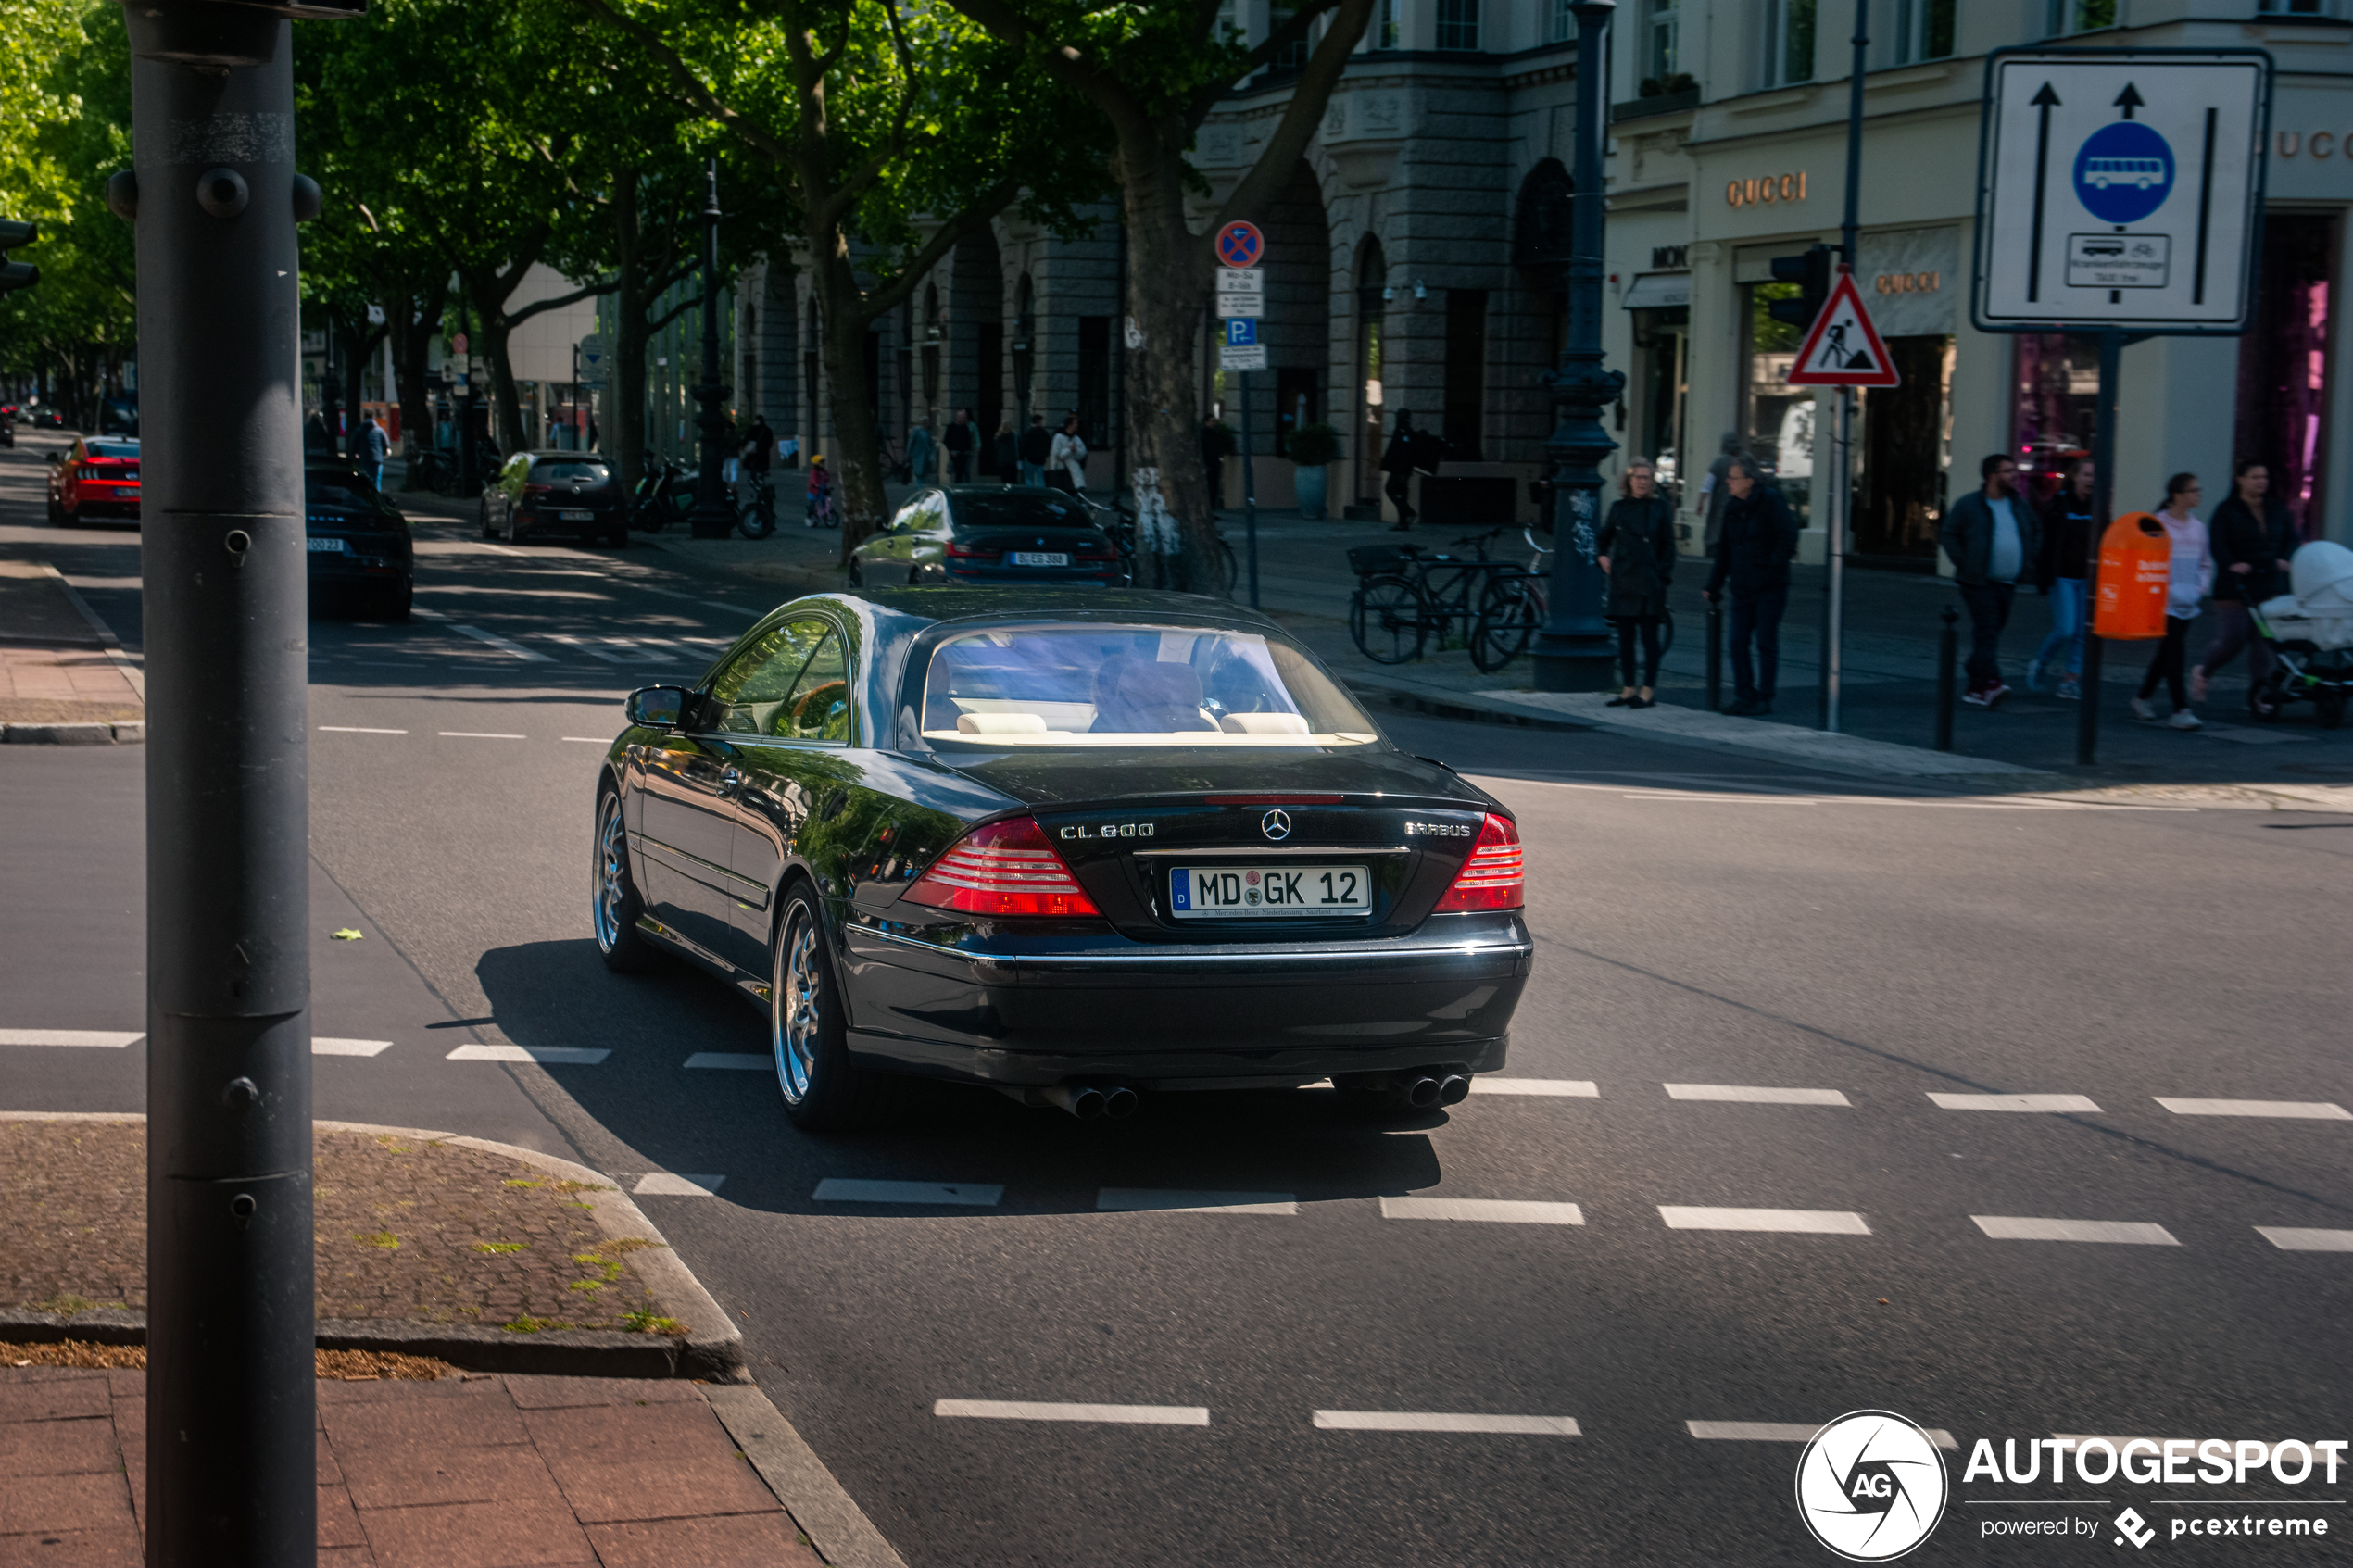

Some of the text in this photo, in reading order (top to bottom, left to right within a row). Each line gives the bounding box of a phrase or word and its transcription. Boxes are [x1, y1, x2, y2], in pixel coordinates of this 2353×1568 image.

[1727, 171, 1806, 207] GUCCI
[1877, 272, 1940, 295] GUCCI
[1231, 320, 1248, 343] P
[327, 540, 340, 549] 23
[1060, 823, 1154, 839] CL 600
[1404, 822, 1471, 837] BRABUS
[1199, 872, 1358, 905] MD GK 12
[1177, 895, 1185, 903] D
[1262, 909, 1303, 917] Niederlassung
